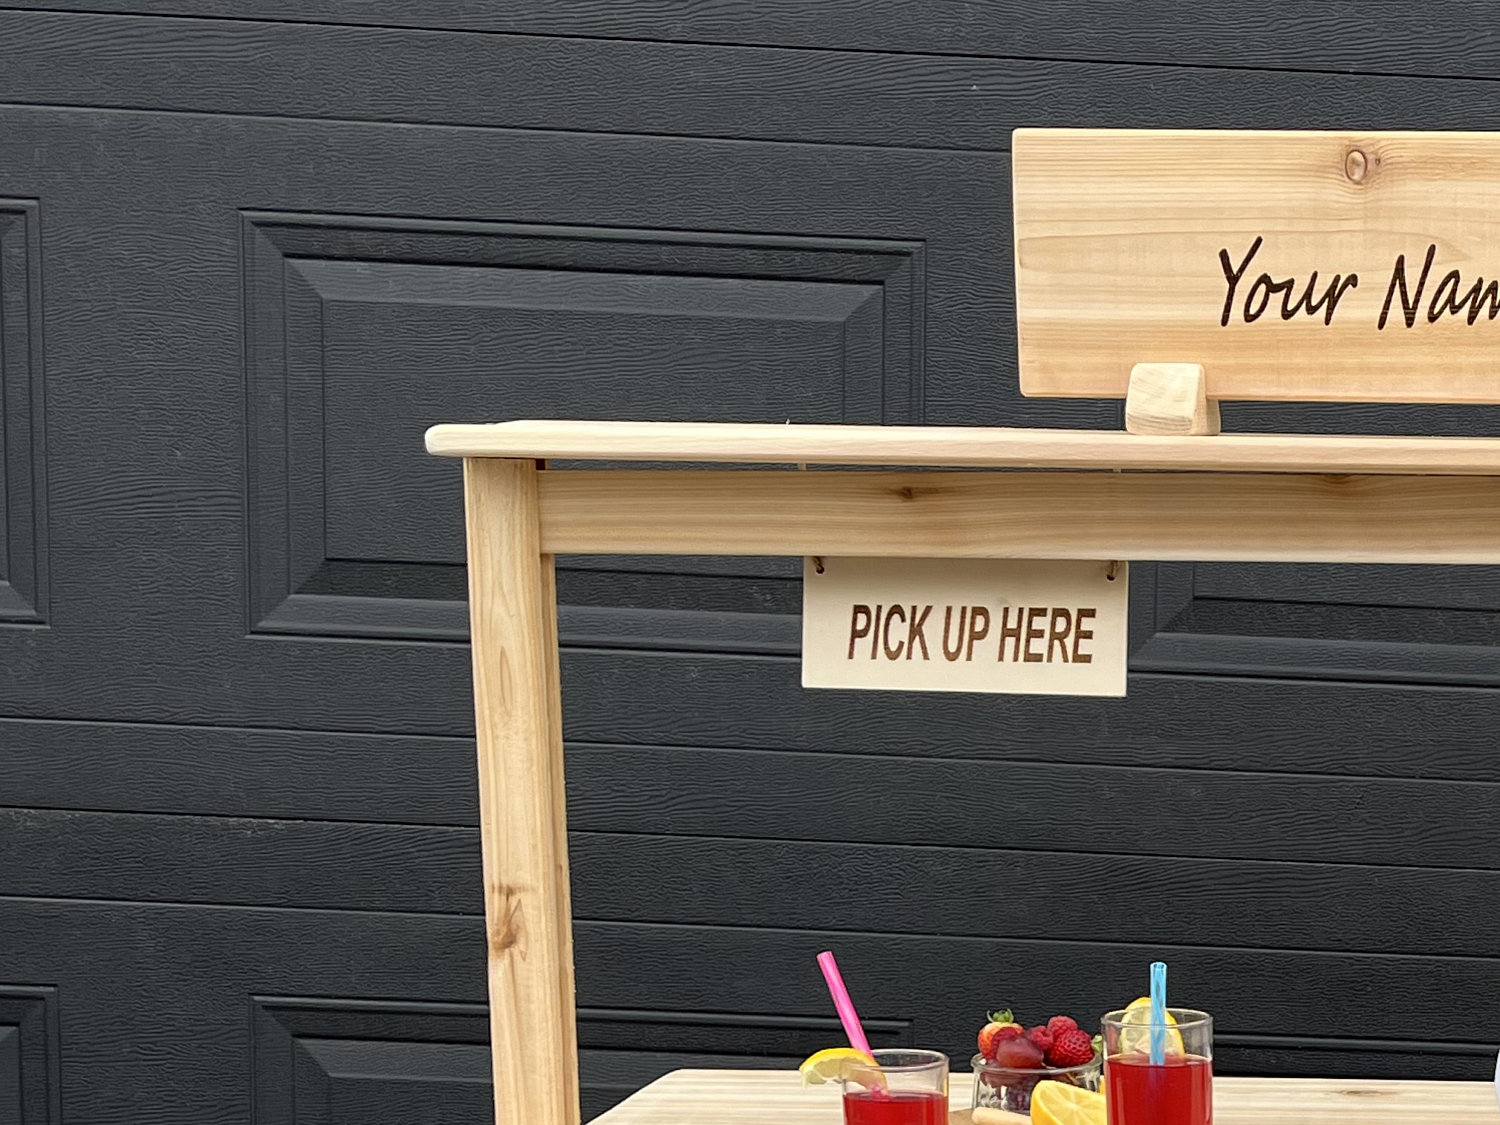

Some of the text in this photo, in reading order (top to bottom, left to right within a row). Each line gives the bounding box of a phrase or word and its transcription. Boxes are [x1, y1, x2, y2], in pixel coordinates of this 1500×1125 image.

[1218, 236, 1359, 327] Your
[848, 603, 1097, 664] PICK UP HERE
